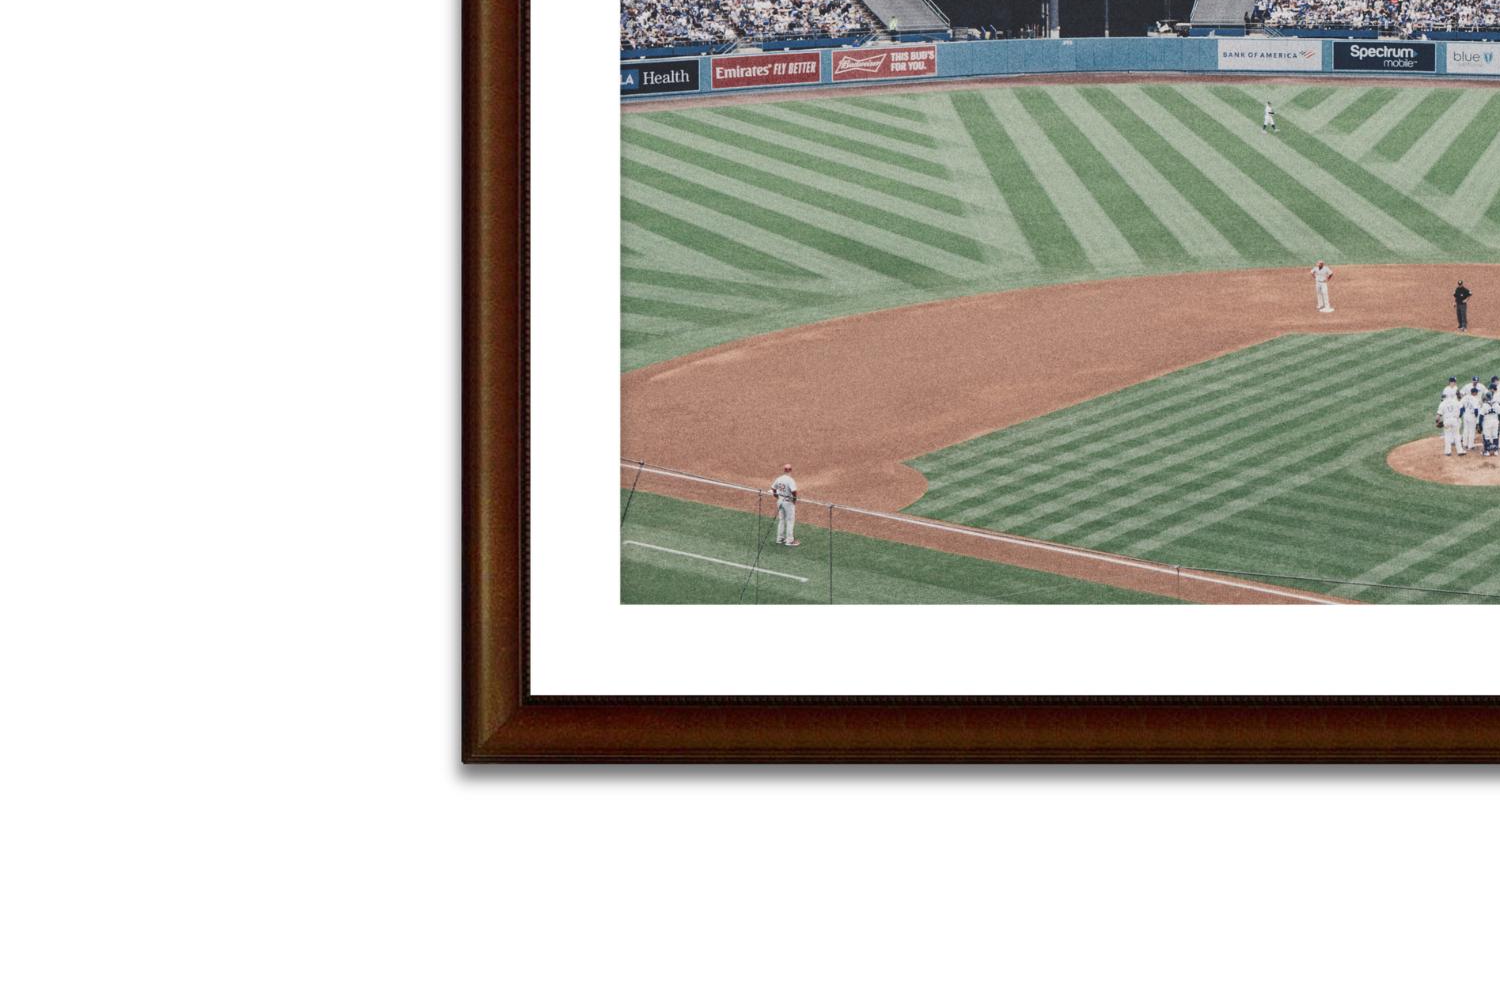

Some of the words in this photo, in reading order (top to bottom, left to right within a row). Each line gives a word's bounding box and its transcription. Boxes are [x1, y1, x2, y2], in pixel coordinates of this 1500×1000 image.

[890, 52, 909, 61] THIS
[910, 51, 935, 61] BUD'S
[1350, 45, 1414, 60] Spectrum
[1453, 51, 1481, 62] blue
[890, 62, 907, 72] FOR
[1383, 59, 1414, 68] mobile
[715, 64, 769, 80] Emirates
[773, 63, 787, 75] FLY
[788, 61, 817, 75] BETTER
[643, 69, 690, 85] Health
